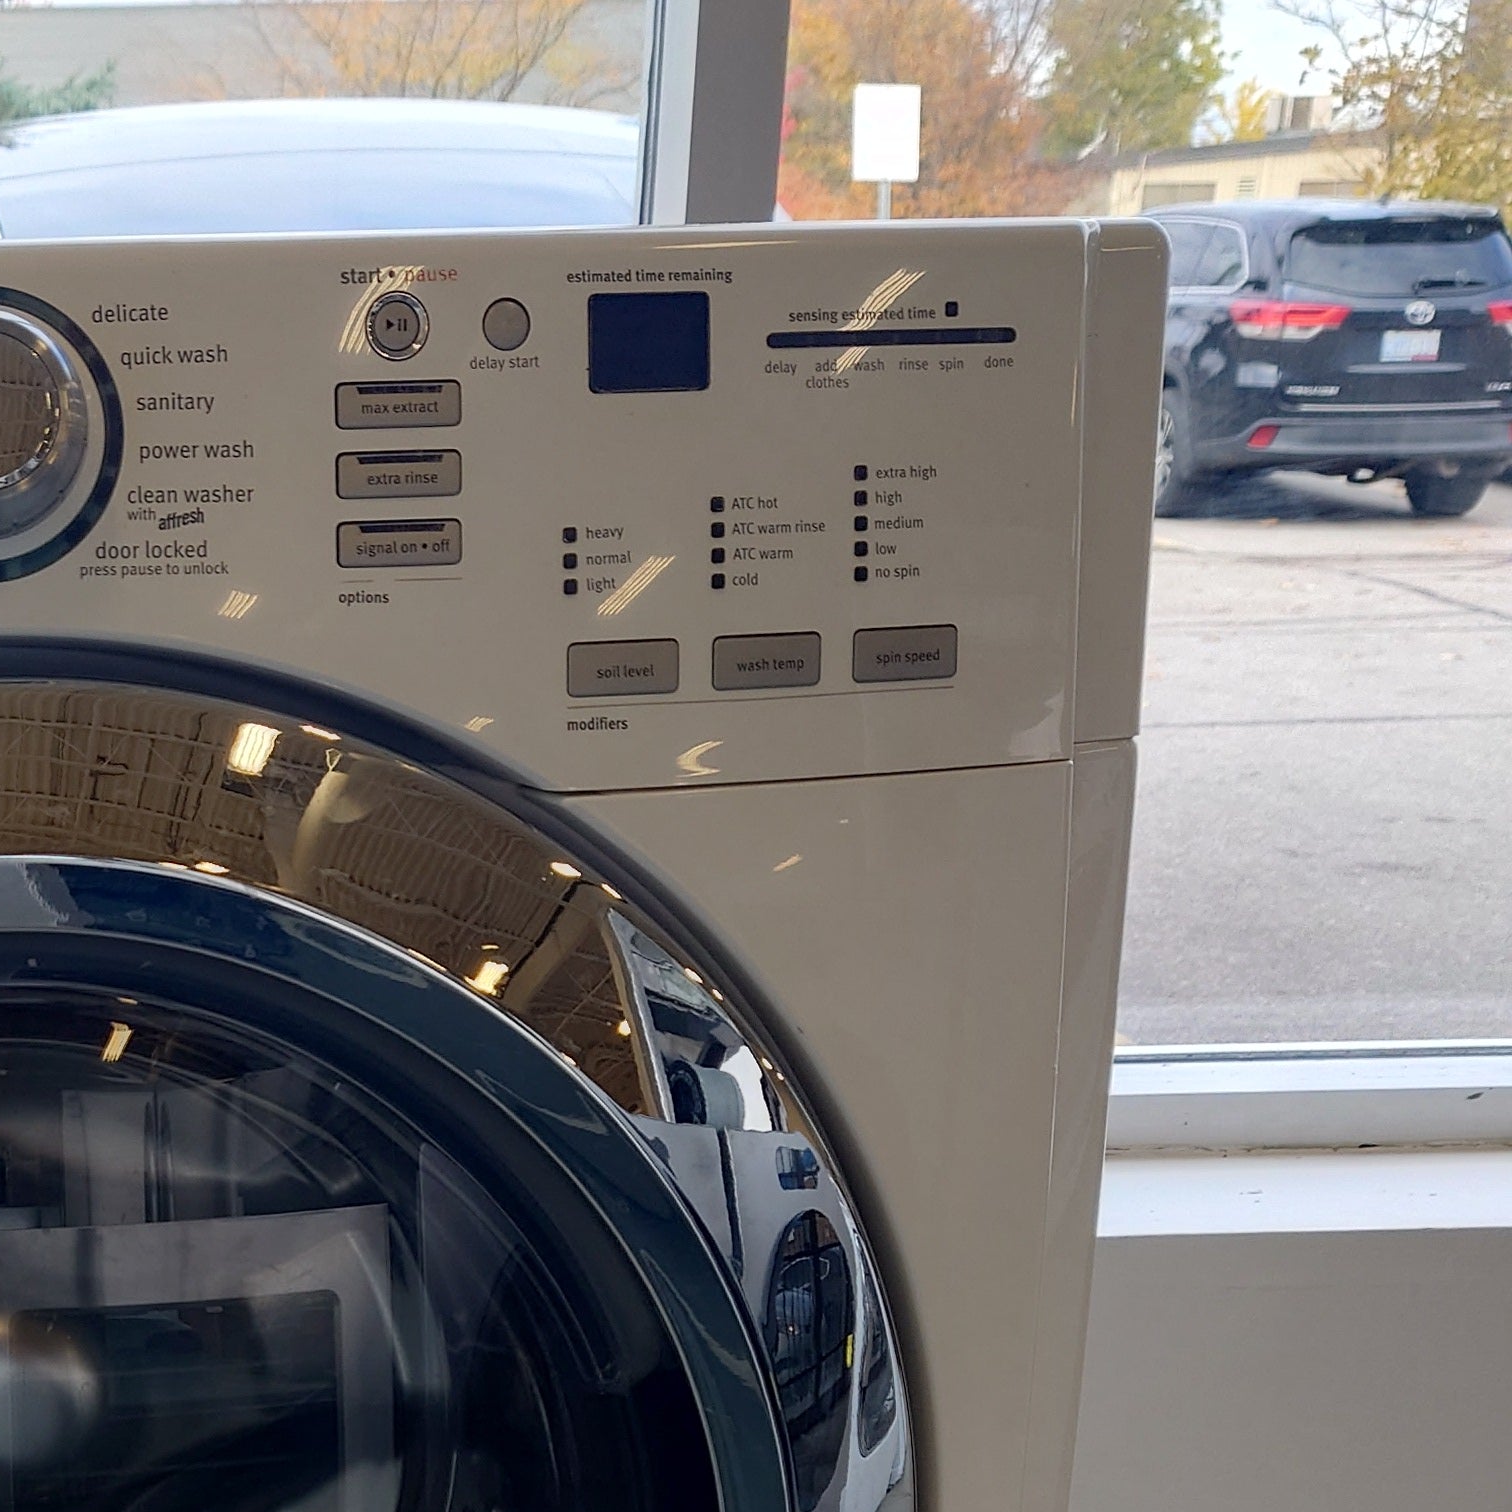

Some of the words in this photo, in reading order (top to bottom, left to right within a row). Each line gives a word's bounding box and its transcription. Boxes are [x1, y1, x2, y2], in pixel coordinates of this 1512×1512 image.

[340, 267, 382, 285] start
[404, 267, 458, 285] pause
[567, 269, 632, 283] estimated
[636, 269, 665, 282] time
[668, 268, 733, 284] remaining
[91, 304, 169, 323] delicate
[789, 308, 838, 323] sensing
[842, 306, 904, 321] estimated
[908, 305, 936, 320] time
[120, 345, 173, 370] quick
[178, 344, 228, 363] wash
[469, 356, 506, 372] delay
[509, 356, 540, 369] start
[765, 360, 797, 376] delay
[815, 359, 837, 373] add
[854, 358, 885, 372] wash
[899, 357, 929, 371] rinse
[939, 356, 964, 372] spin
[984, 355, 1014, 369] done
[806, 376, 849, 389] clothes
[136, 392, 215, 415] sanitary
[361, 402, 389, 414] max
[392, 401, 439, 414] extract
[139, 443, 200, 464] power
[204, 440, 255, 459] wash
[367, 472, 401, 486] extra
[405, 471, 438, 485] rinse
[875, 467, 906, 479] extra
[909, 465, 937, 481] high
[127, 485, 178, 504] clean
[184, 484, 255, 503] washer
[875, 491, 903, 506] high
[731, 497, 755, 510] ATC
[758, 496, 778, 510] hot
[127, 508, 156, 521] with
[158, 507, 205, 531] affresh
[875, 516, 924, 530] medium
[586, 525, 624, 541] heavy
[732, 522, 756, 535] ATC
[758, 523, 791, 535] warm
[795, 520, 826, 533] rinse
[95, 541, 140, 559] door
[145, 540, 208, 558] locked
[356, 541, 397, 557] signal
[400, 542, 417, 553] on
[432, 538, 450, 552] off
[733, 547, 757, 560] ATC
[759, 548, 793, 560] warm
[875, 542, 897, 555] low
[586, 551, 631, 566] normal
[80, 565, 117, 579] press
[121, 564, 163, 579] pause
[166, 562, 180, 575] to
[184, 561, 229, 575] unlock
[875, 567, 891, 578] no
[894, 564, 920, 580] spin
[586, 576, 616, 593] light
[732, 572, 758, 587] cold
[338, 590, 390, 606] options
[737, 657, 769, 673] wash
[772, 657, 805, 673] temp
[876, 650, 902, 666] spin
[904, 649, 940, 665] speed
[596, 664, 620, 679] soil
[623, 663, 654, 678] level
[567, 717, 628, 731] modifiers
